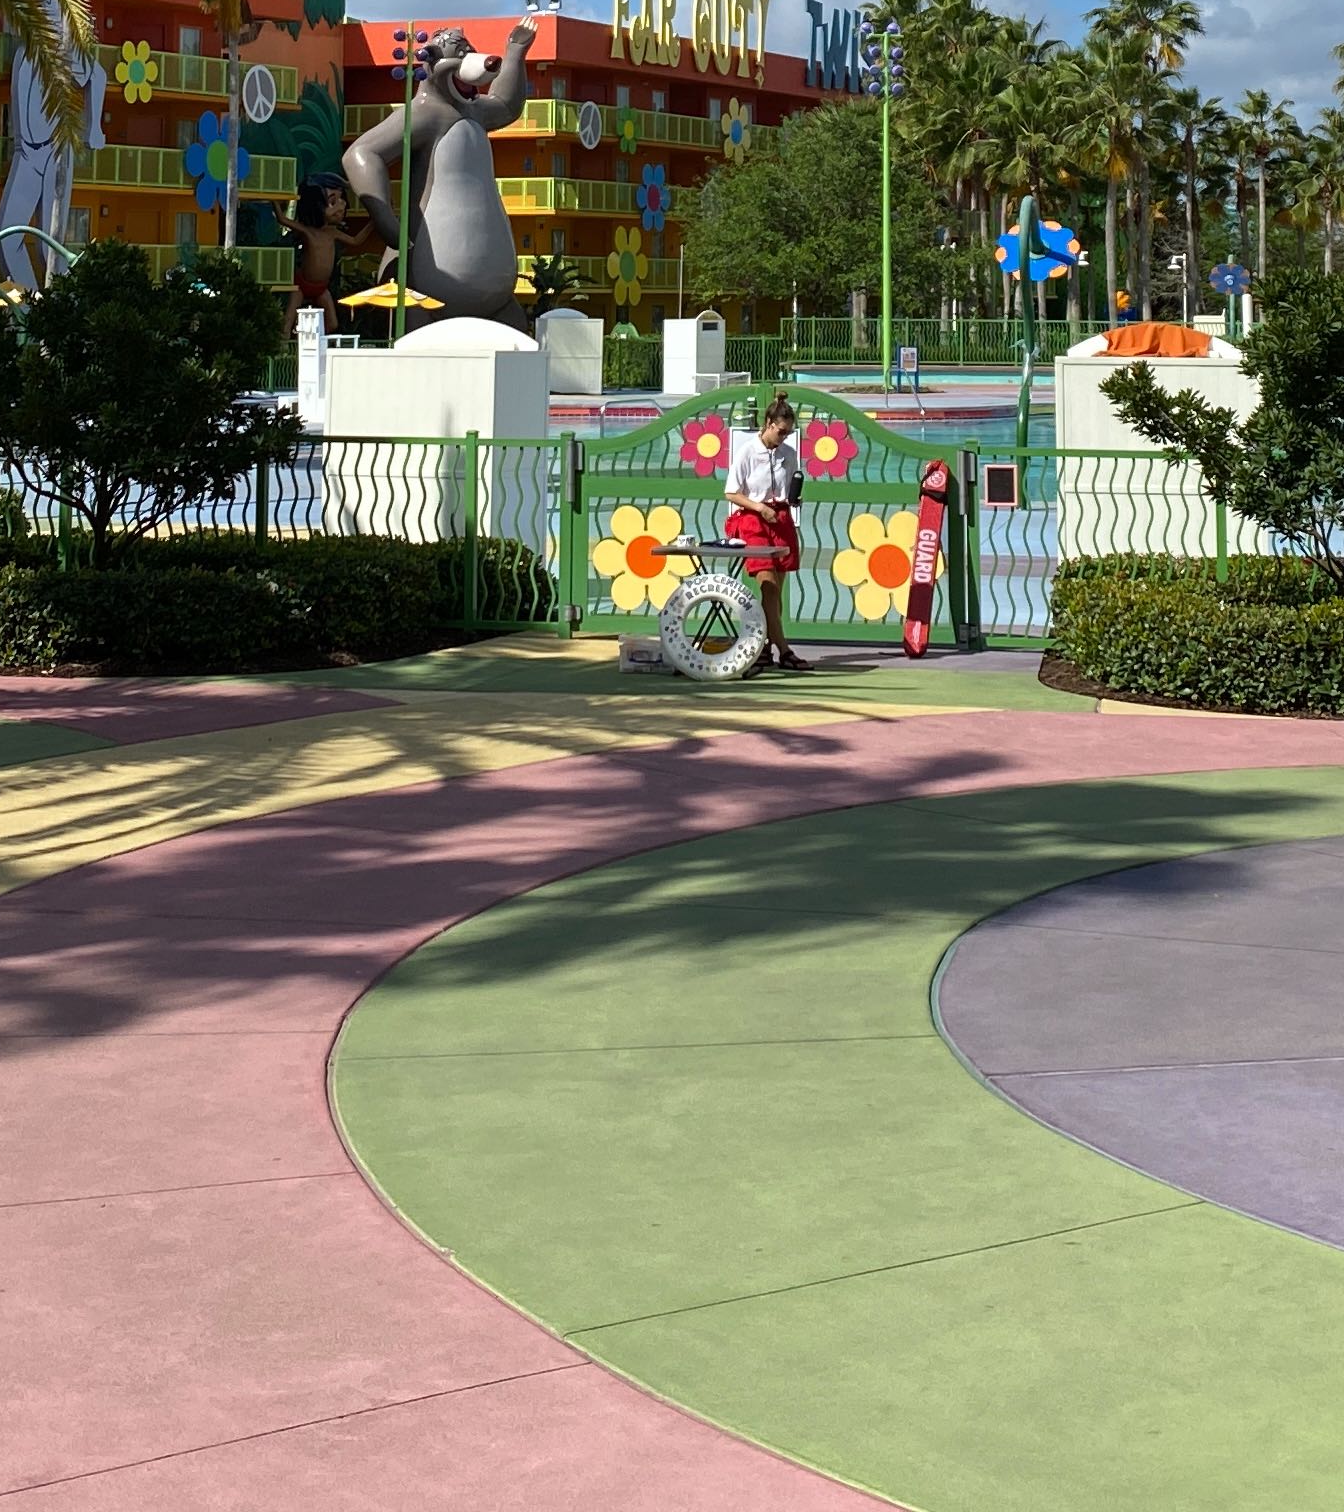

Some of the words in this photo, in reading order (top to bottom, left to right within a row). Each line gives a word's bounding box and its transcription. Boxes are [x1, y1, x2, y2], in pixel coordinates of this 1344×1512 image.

[914, 529, 937, 584] GUARD
[685, 583, 753, 611] RECREATION
[686, 576, 709, 588] POP
[712, 575, 756, 601] CENTURY
